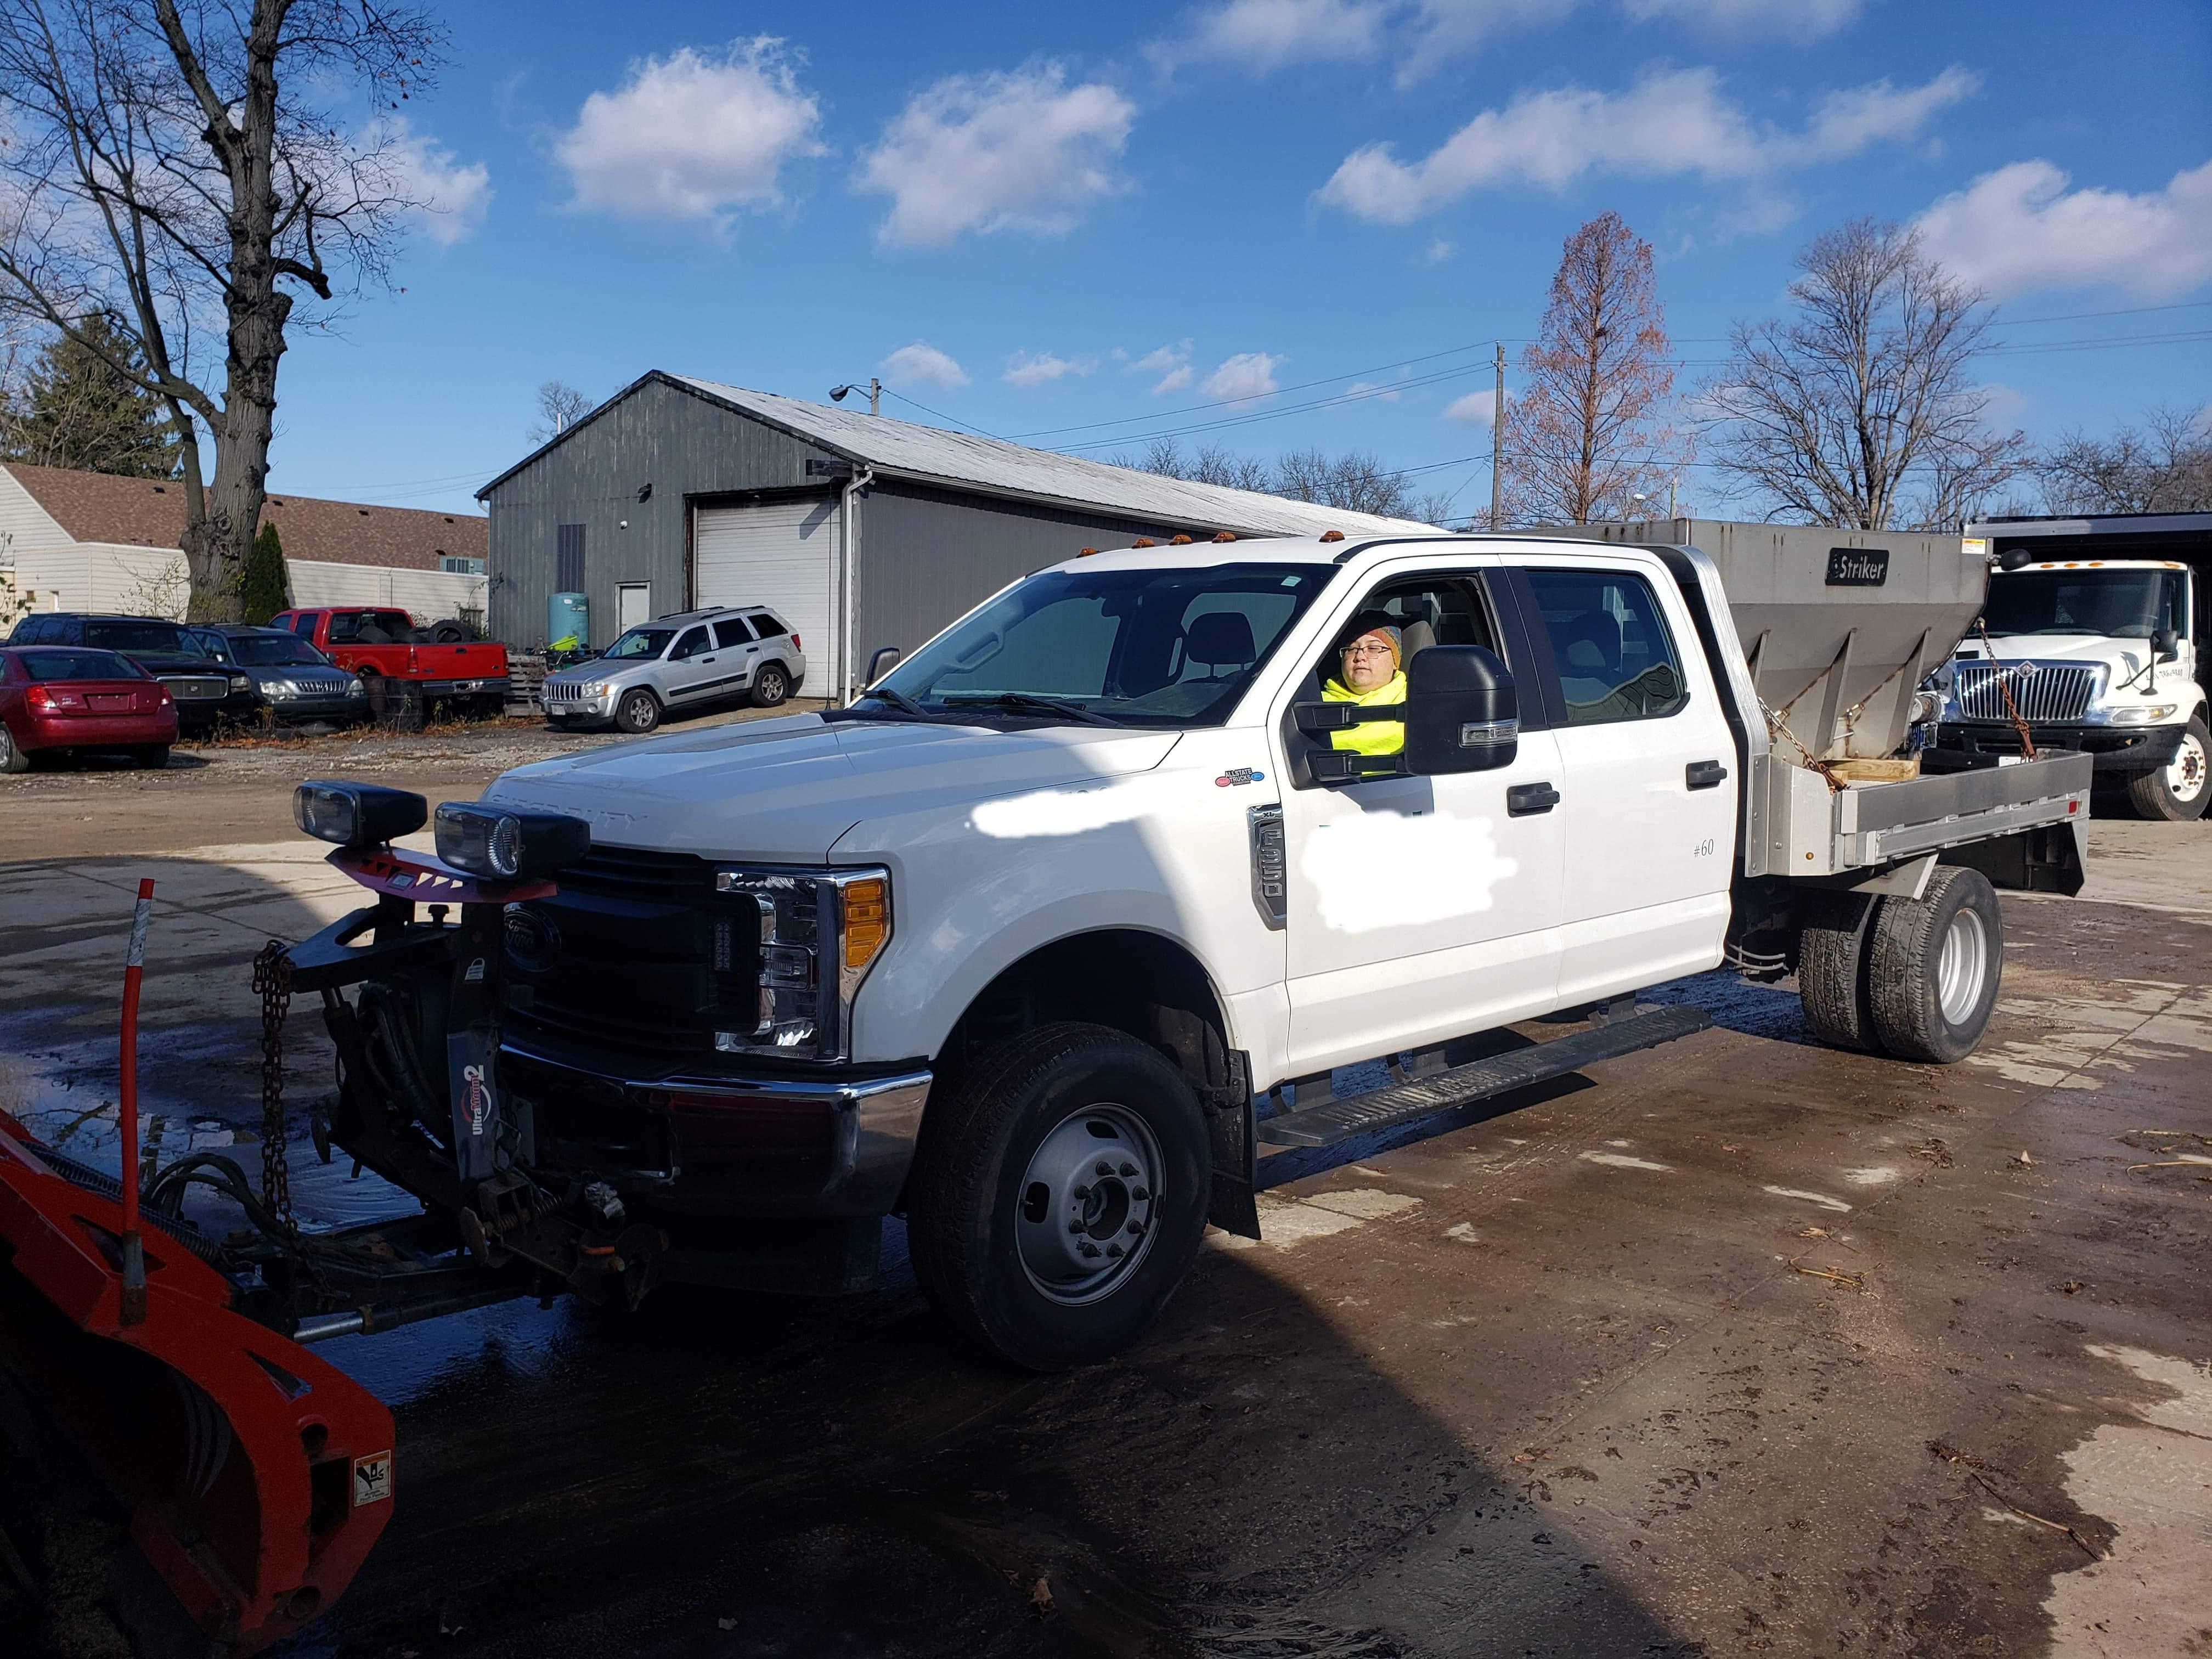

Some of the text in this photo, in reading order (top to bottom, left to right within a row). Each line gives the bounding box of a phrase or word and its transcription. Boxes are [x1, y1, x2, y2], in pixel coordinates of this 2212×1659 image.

[1839, 555, 1884, 580] Striker
[1225, 768, 1252, 778] ALLSTATE
[1229, 774, 1251, 783] TRUCKS
[1694, 838, 1714, 858] #60
